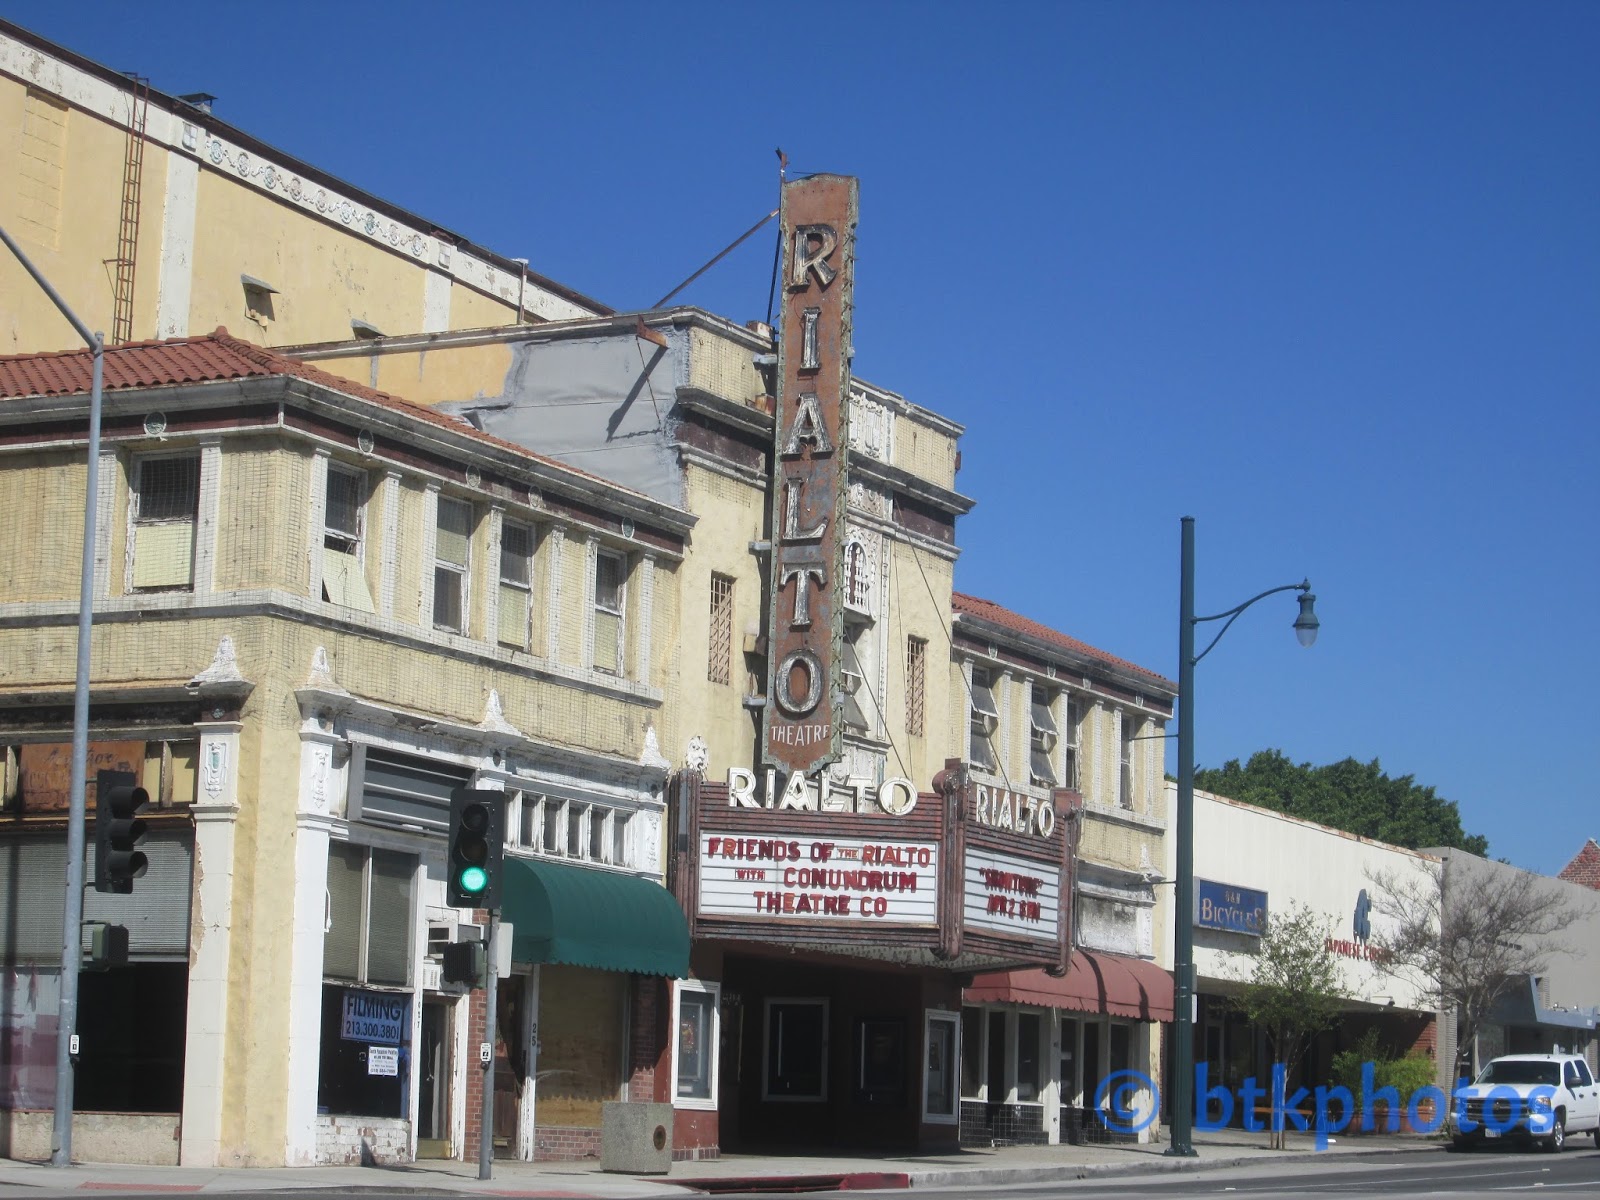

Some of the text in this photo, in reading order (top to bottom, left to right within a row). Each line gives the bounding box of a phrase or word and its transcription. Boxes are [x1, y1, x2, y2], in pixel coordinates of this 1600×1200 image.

[777, 224, 838, 715] RIALTO
[771, 724, 830, 746] THEATRE
[727, 767, 918, 816] RIALTO
[976, 784, 1055, 838] RIALTO
[708, 837, 930, 868] FRIENDS OF THE RIALTO
[736, 867, 917, 893] WITH CONUNDRUM
[753, 891, 887, 917] THEATRE CO
[1202, 898, 1262, 931] BICYCLES
[347, 994, 401, 1021] FILMING
[346, 1020, 399, 1040] 213.300.3801
[532, 1023, 537, 1047] 25
